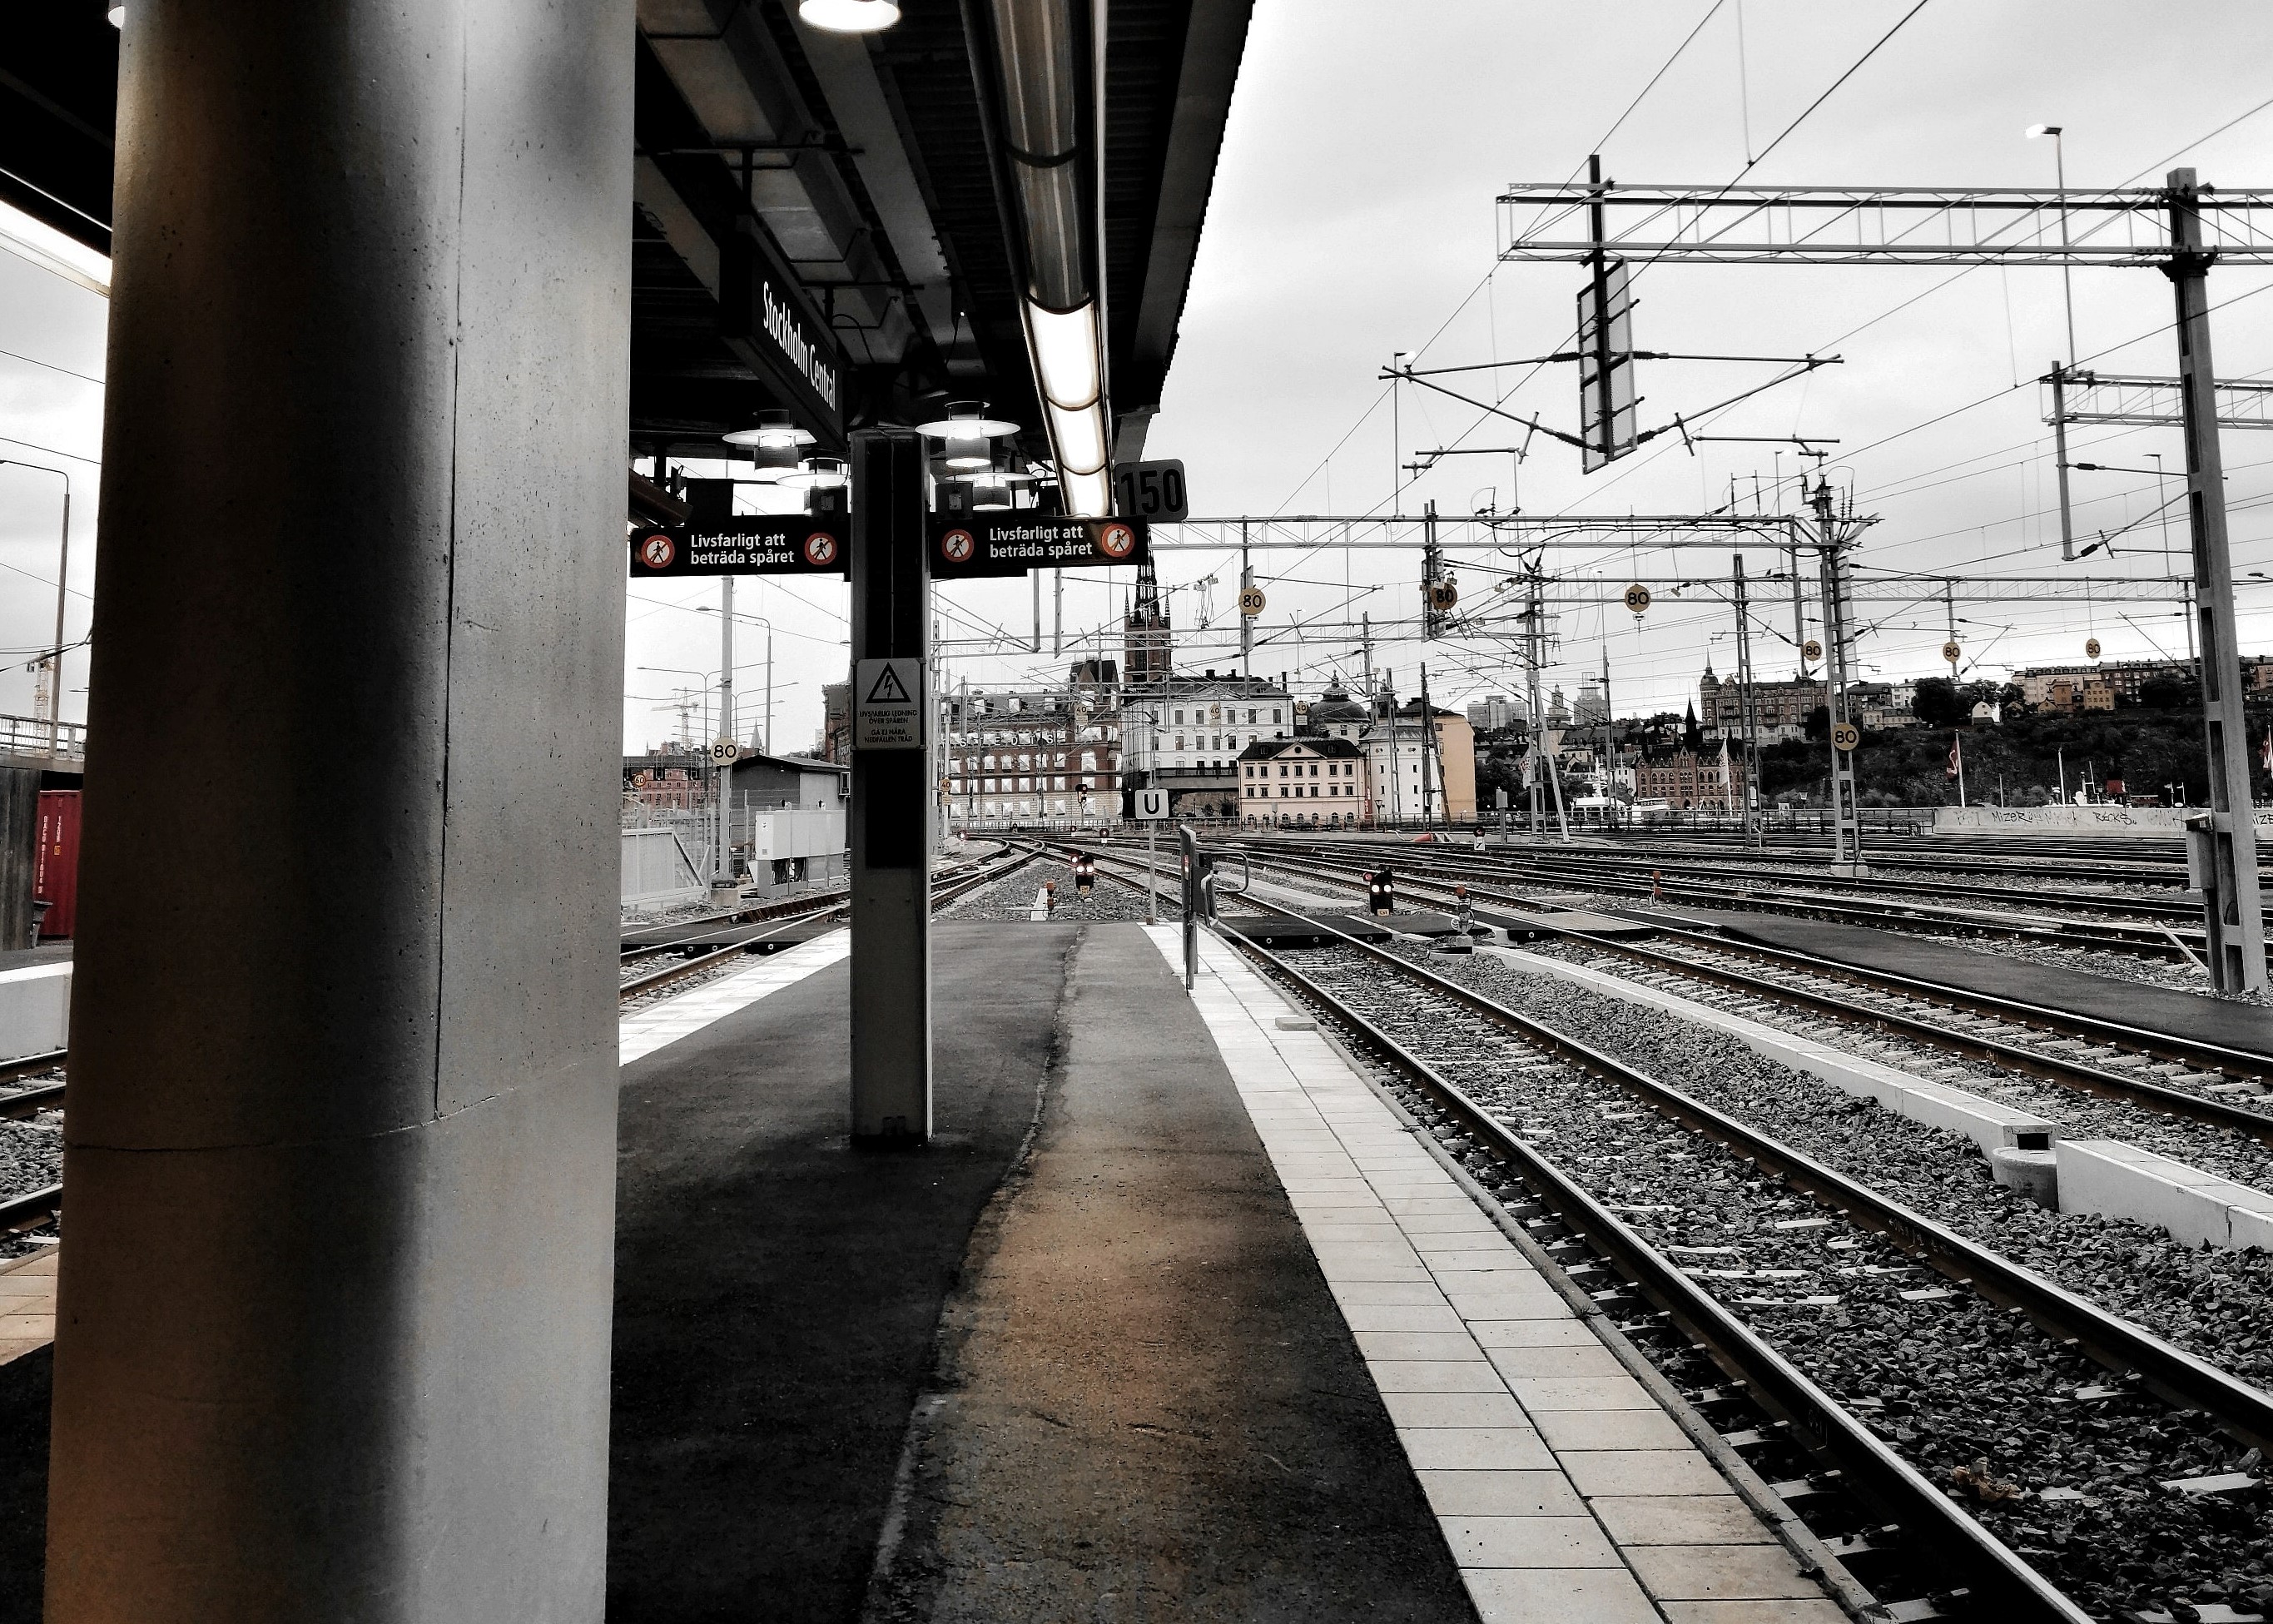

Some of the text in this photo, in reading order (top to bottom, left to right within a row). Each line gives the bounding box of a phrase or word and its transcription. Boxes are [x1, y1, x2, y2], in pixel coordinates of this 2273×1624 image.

[763, 281, 836, 412] Stockholm Central
[1120, 469, 1184, 515] 150
[990, 525, 1084, 542] Livsfarligt att
[690, 533, 786, 550] Livsfarligt att
[690, 549, 795, 566] beträda spåret
[990, 542, 1093, 559] beträda spåret
[1243, 594, 1263, 608] 80
[1437, 589, 1454, 603] 80
[1628, 592, 1650, 606] 80
[1806, 645, 1821, 656] 80
[1945, 646, 1960, 657] 80
[2087, 643, 2101, 654] 80
[1834, 730, 1857, 744] 80
[714, 744, 737, 759] 80
[635, 776, 645, 784] 60
[1144, 793, 1160, 815] U
